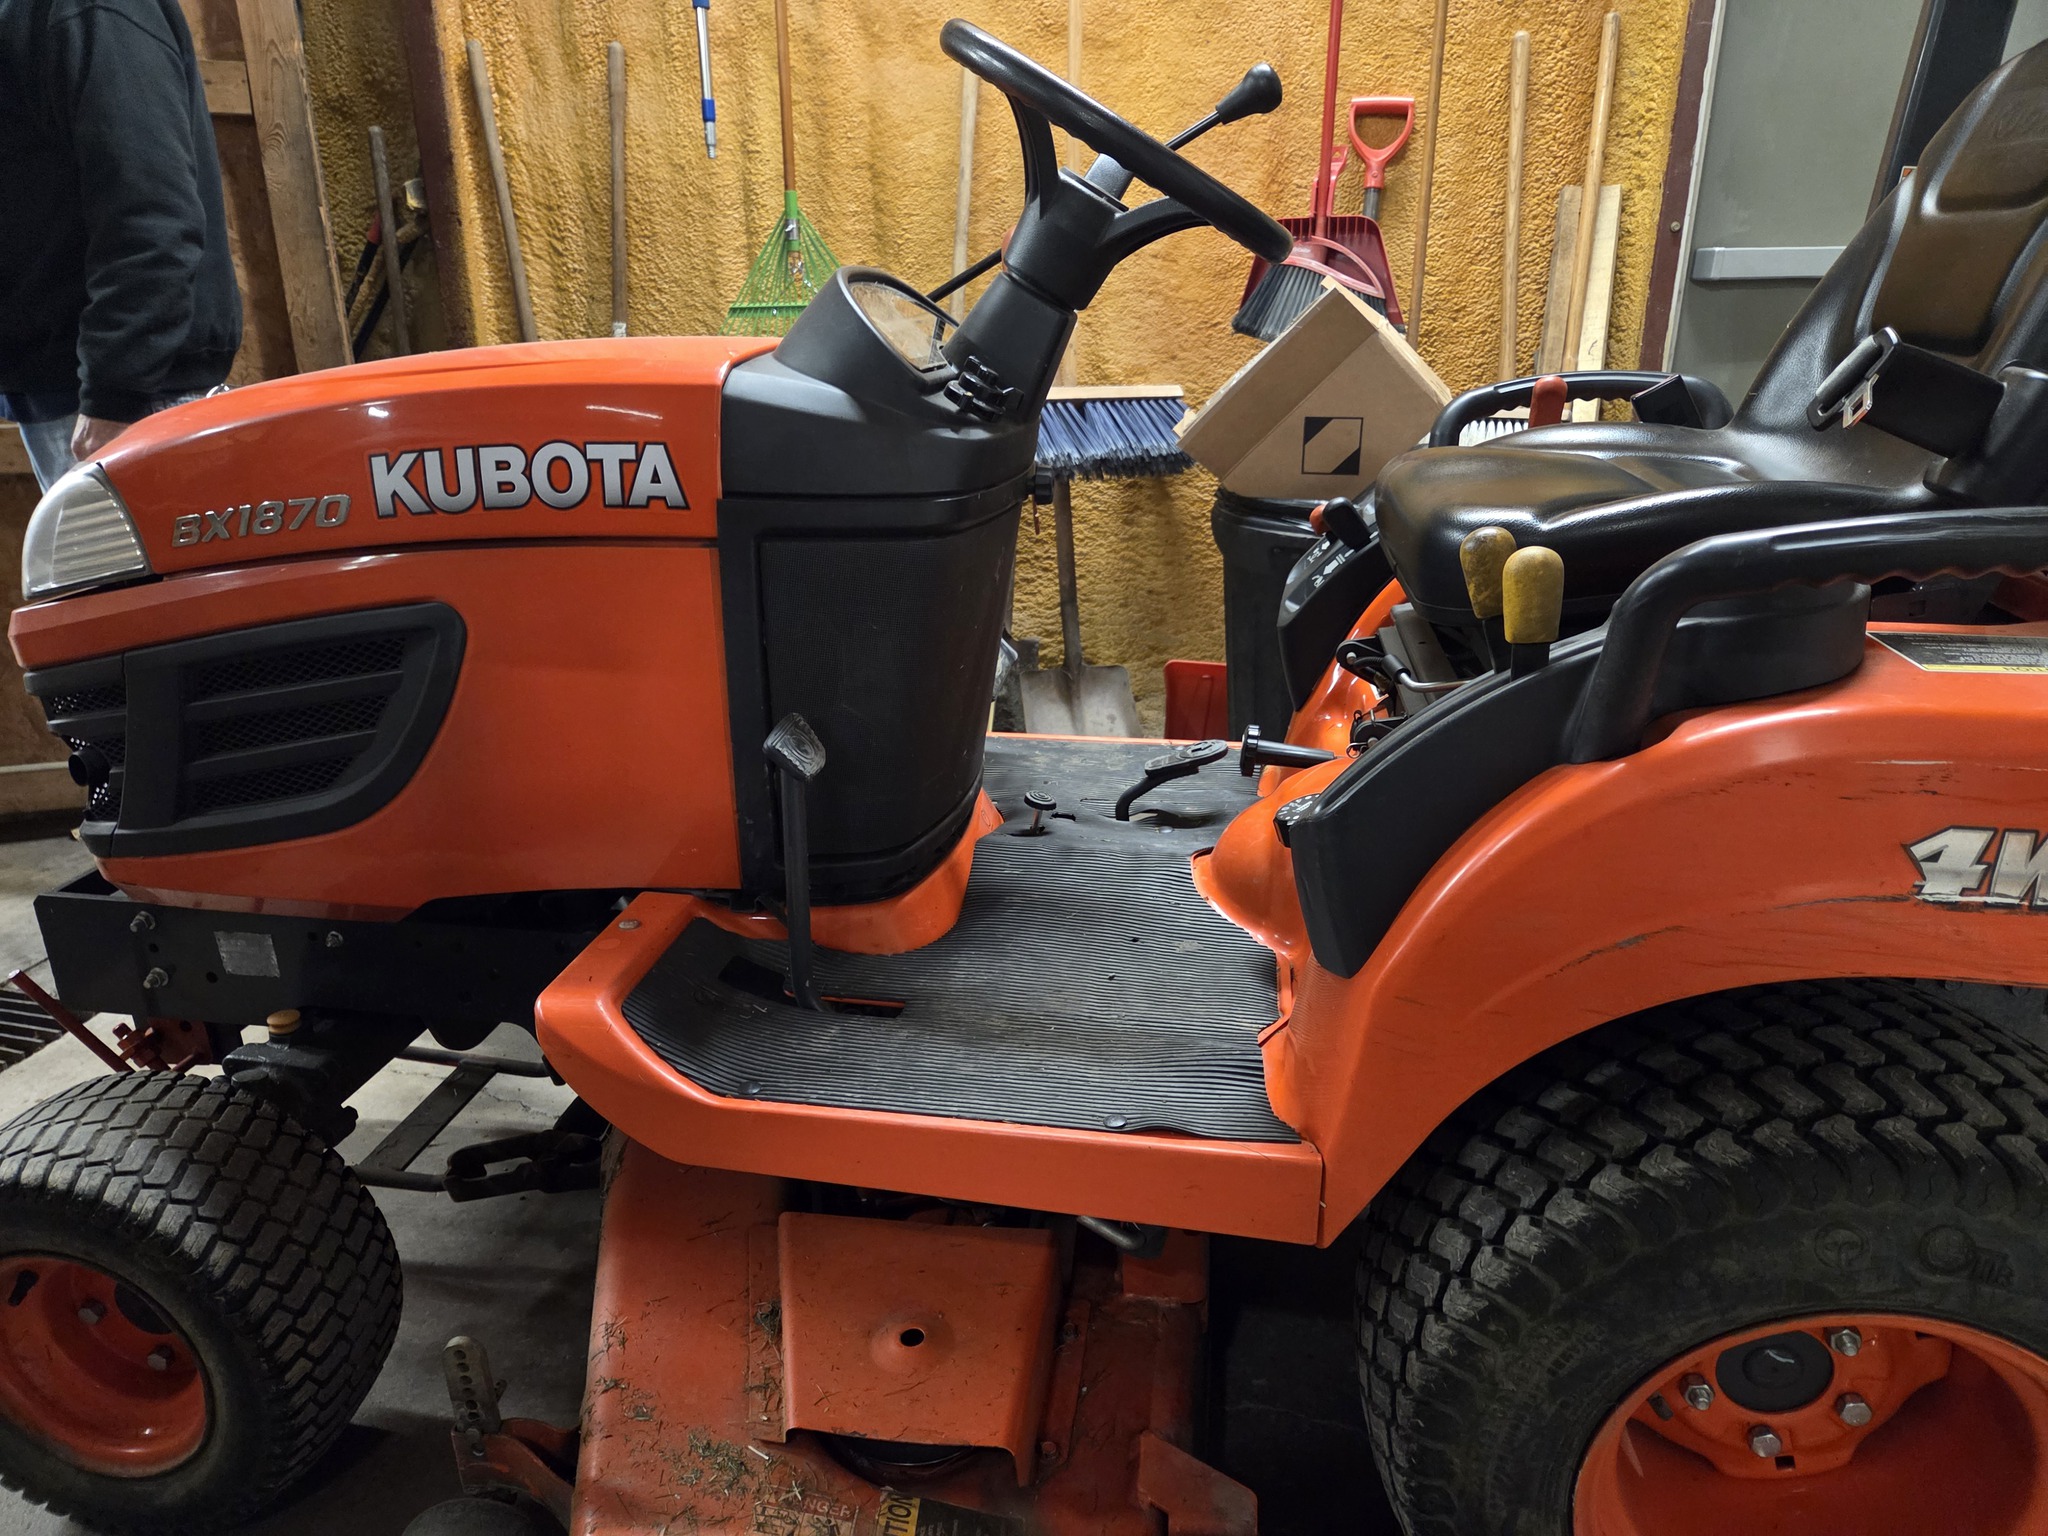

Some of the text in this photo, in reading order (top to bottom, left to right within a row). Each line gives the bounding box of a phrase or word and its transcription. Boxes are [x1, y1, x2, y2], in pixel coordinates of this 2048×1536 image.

[368, 441, 690, 518] KUBOTA
[171, 493, 351, 548] BX1870
[884, 1497, 913, 1536] TION
